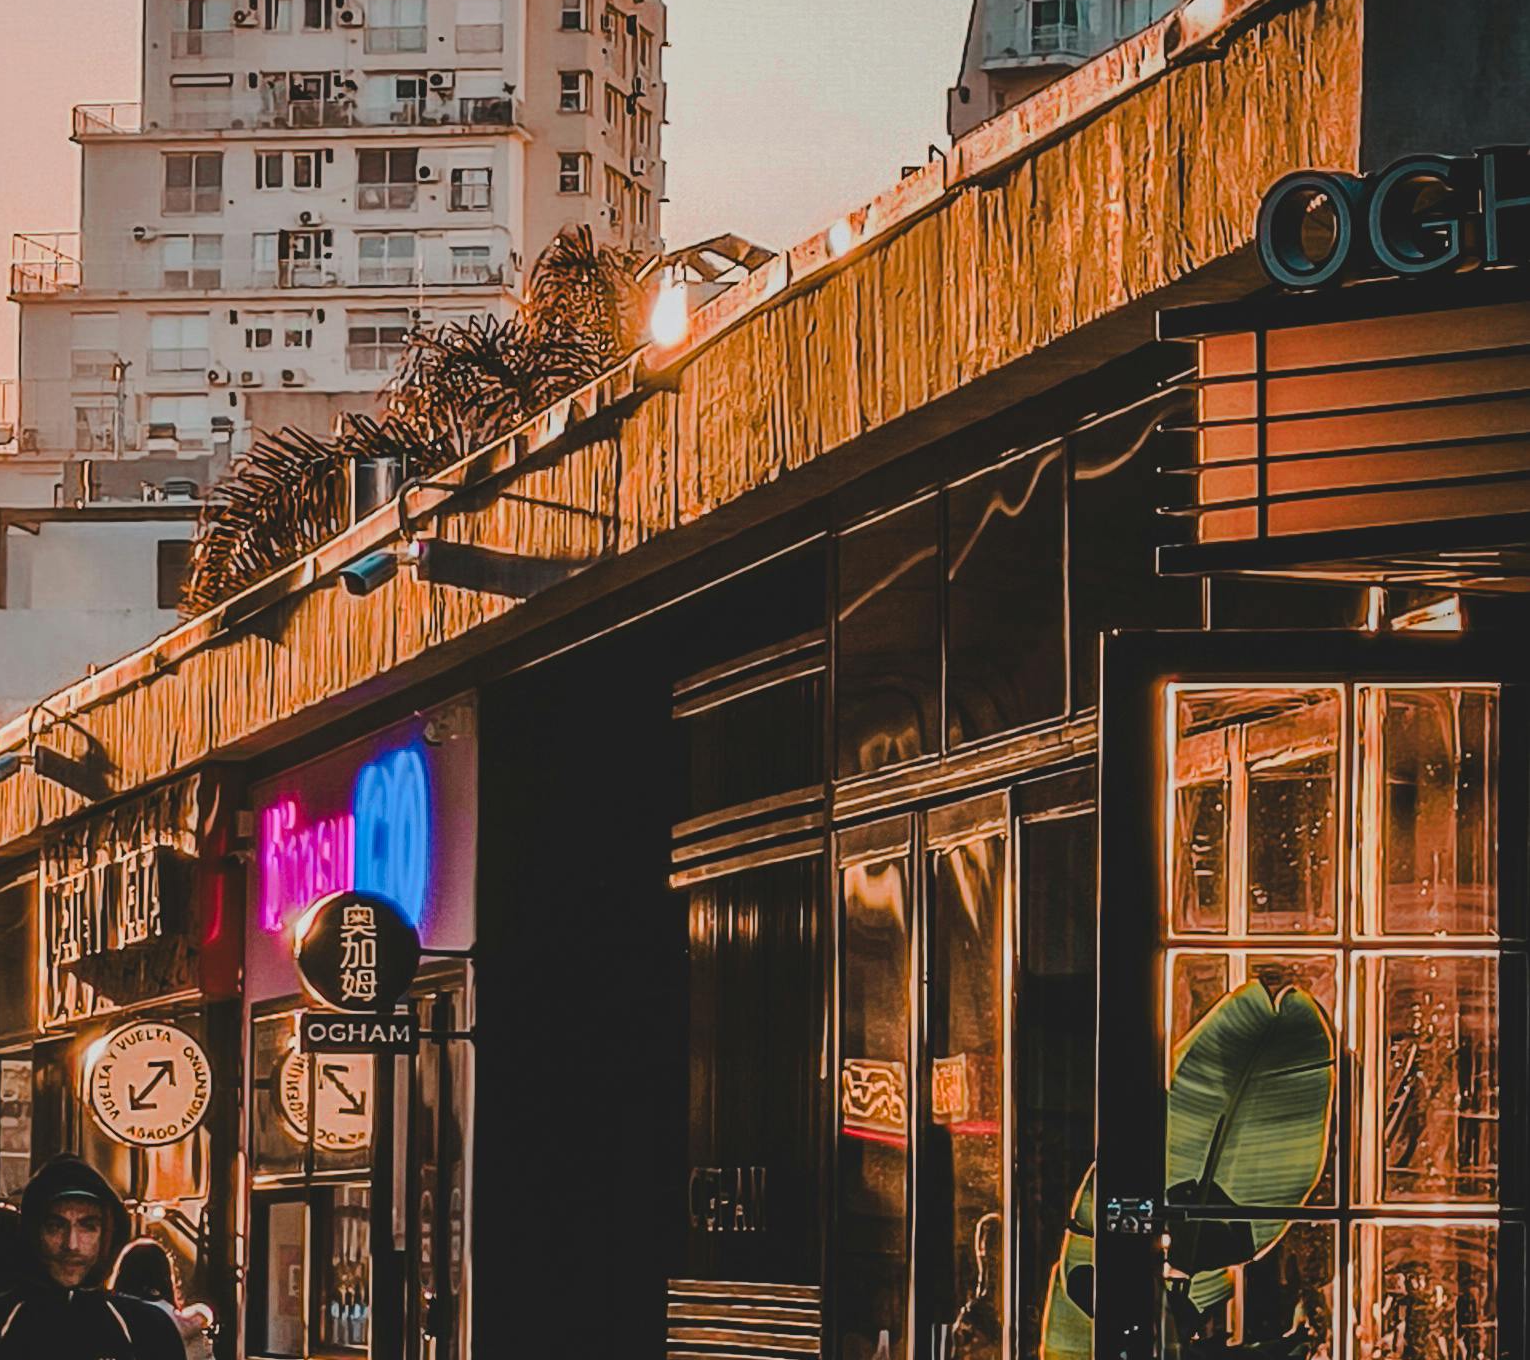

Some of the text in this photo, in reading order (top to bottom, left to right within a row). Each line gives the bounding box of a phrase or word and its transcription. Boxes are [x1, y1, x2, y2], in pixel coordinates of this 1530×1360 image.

[307, 1023, 411, 1043] OGHAM
[98, 1064, 121, 1121] VUELTA
[115, 1028, 173, 1052] VUELTA
